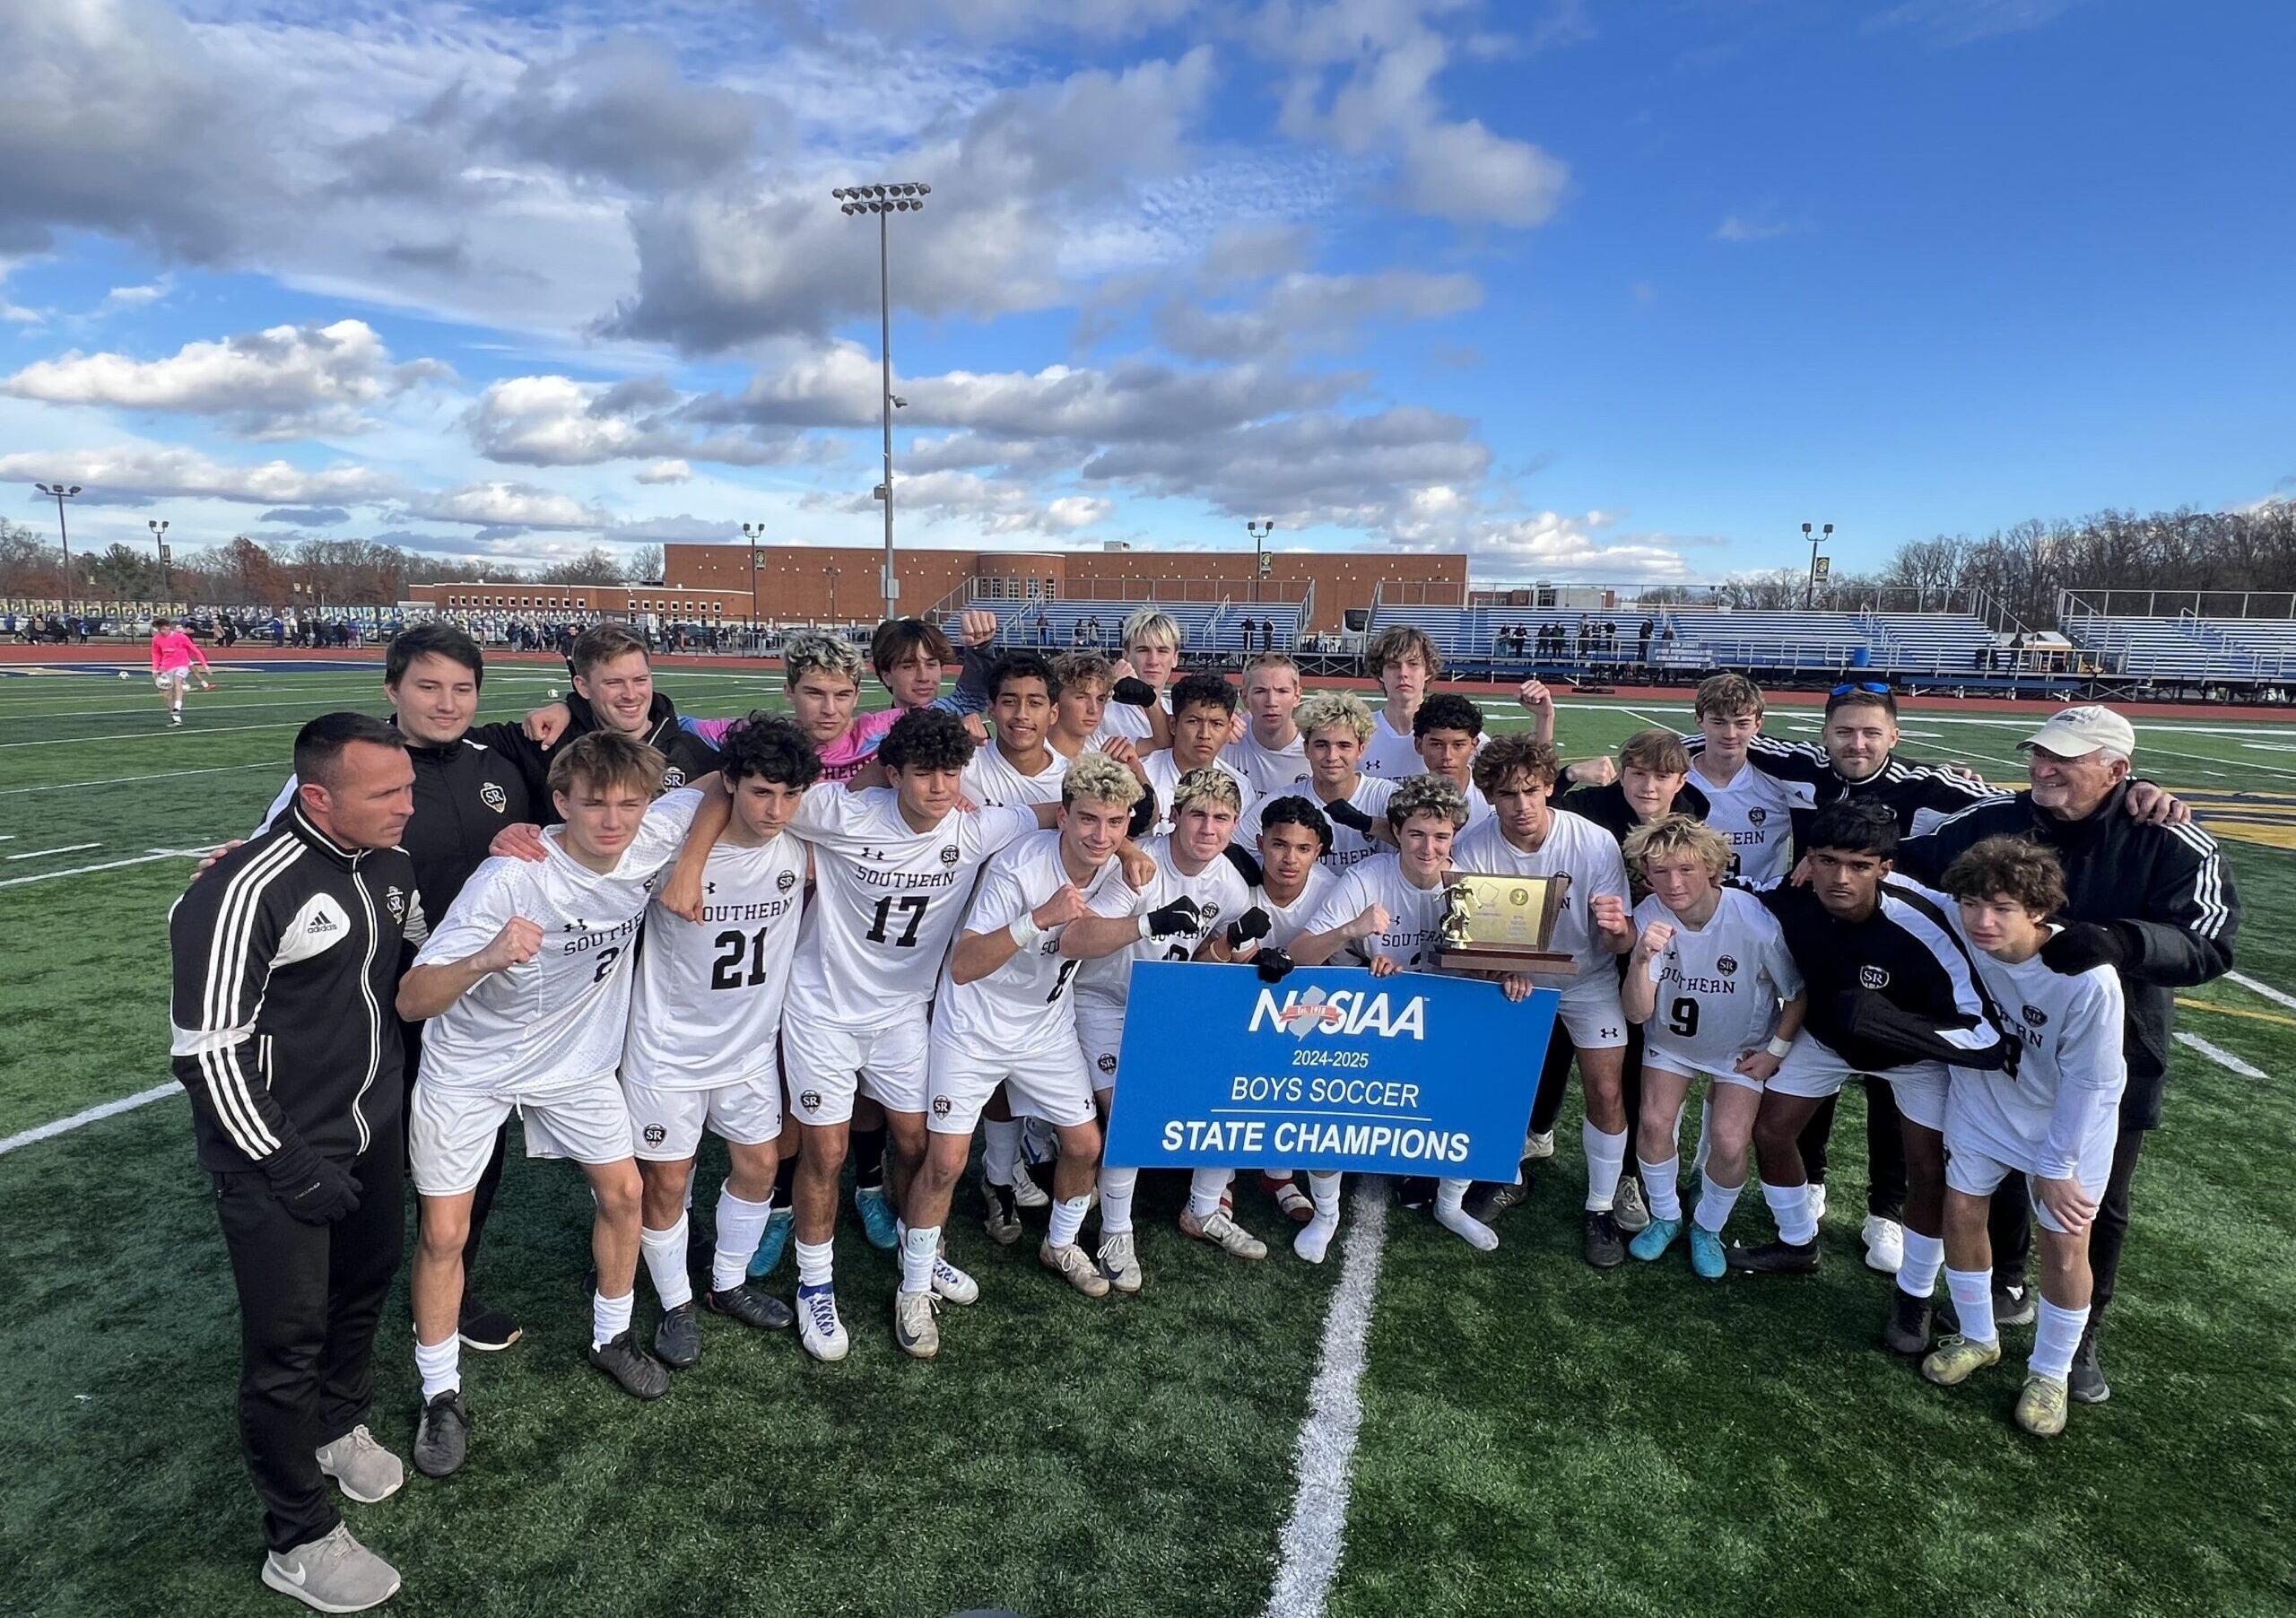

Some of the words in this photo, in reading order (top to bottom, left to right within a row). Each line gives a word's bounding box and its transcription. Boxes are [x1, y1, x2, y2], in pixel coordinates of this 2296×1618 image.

[664, 773, 682, 786] SR
[485, 790, 503, 804] SR
[942, 851, 958, 861] SR
[1318, 846, 1378, 866] UTHERN
[856, 866, 956, 888] SOUTHERN
[702, 897, 793, 921] OUTHERN
[308, 923, 337, 933] adidas
[865, 895, 930, 948] 17
[563, 909, 644, 956] SOUTHE
[1382, 929, 1446, 947] SOUTERN
[710, 926, 768, 990] 21
[1719, 961, 1734, 970] SR
[1659, 967, 1735, 994] OUTHERN
[1864, 970, 1883, 984] SR
[1669, 997, 1700, 1038] 9
[1100, 1058, 1115, 1068] SR
[1292, 1050, 1369, 1068] 2024-2025
[804, 1096, 818, 1106] SR
[1231, 1076, 1302, 1101] BOYS
[1309, 1079, 1420, 1108] SOCCER
[935, 1101, 948, 1111] SR
[646, 1129, 662, 1140] SR
[1161, 1121, 1265, 1152] STATE
[1274, 1124, 1470, 1162] CHAMPIONS
